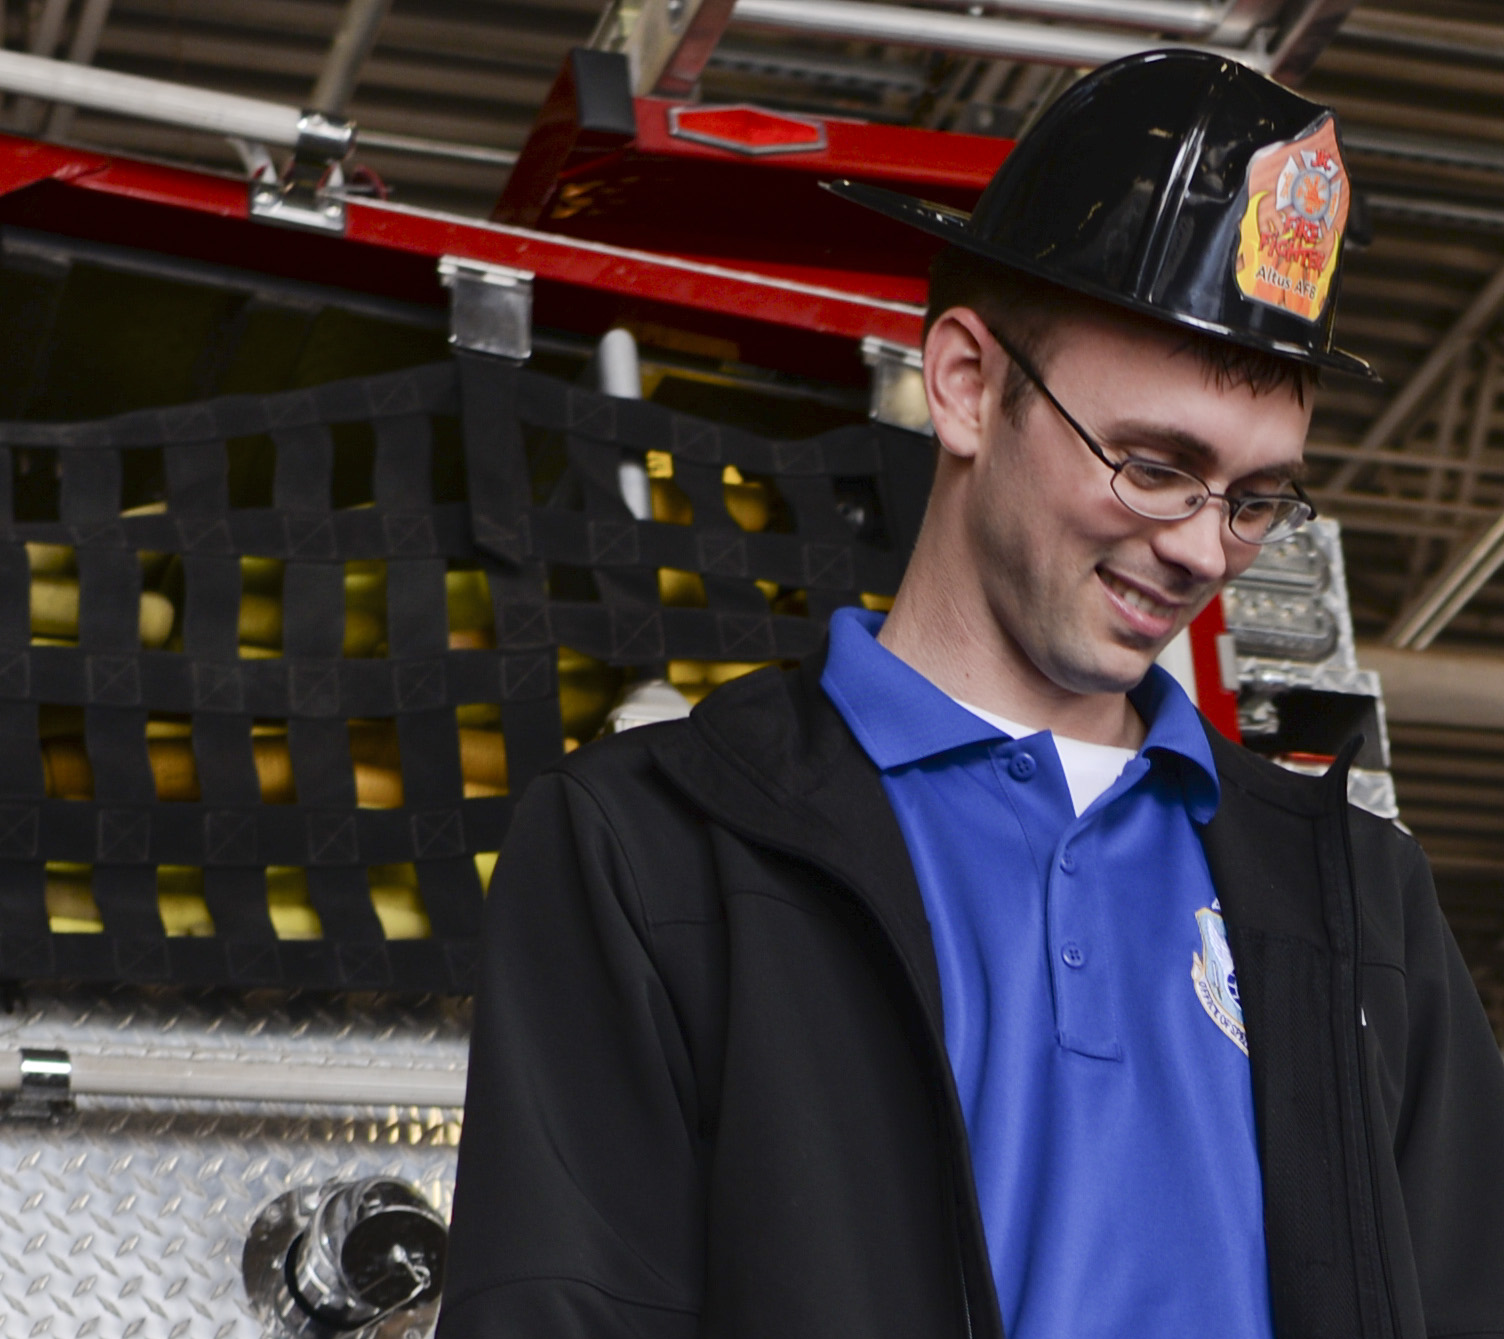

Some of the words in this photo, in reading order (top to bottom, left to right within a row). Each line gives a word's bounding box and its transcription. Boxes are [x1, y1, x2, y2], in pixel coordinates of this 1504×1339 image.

[1282, 216, 1319, 244] FIRE
[1259, 230, 1325, 273] FIGHTER
[1256, 265, 1292, 289] Altus
[1294, 279, 1317, 300] AFB
